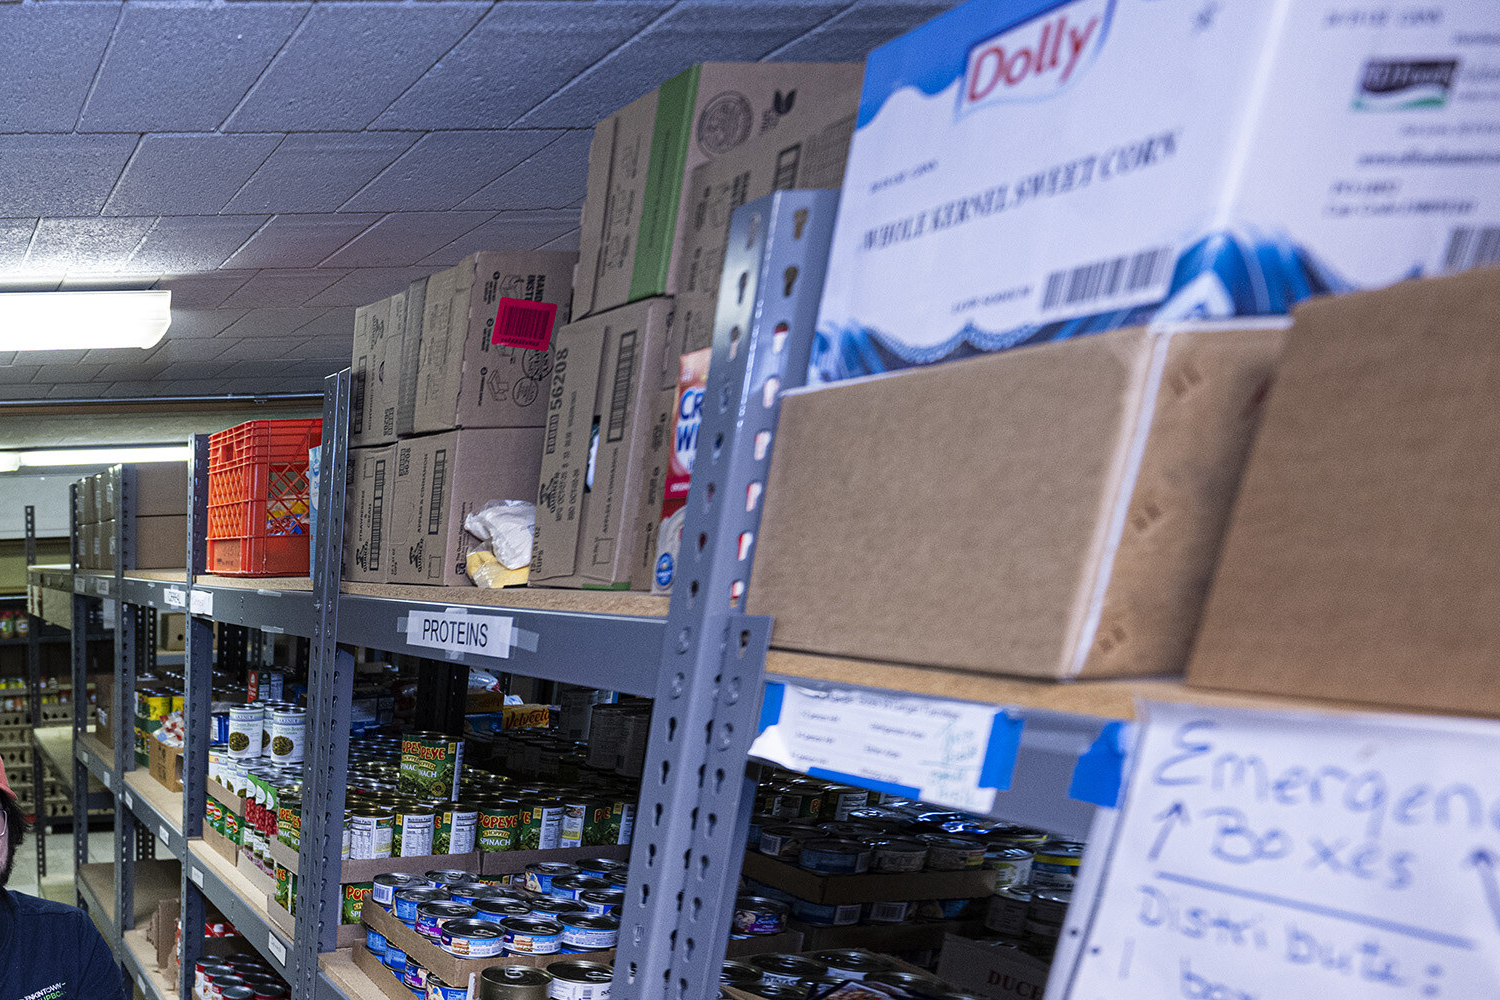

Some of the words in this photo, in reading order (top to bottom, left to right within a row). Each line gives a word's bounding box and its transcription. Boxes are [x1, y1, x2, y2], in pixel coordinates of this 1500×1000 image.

[968, 15, 1099, 104] Dolly
[550, 348, 569, 412] 56208
[422, 618, 489, 648] PROTEINS
[418, 745, 446, 761] PEYE
[478, 812, 518, 829] POPEYE
[479, 838, 512, 847] SPINACH
[987, 969, 1044, 1000] DUCH
